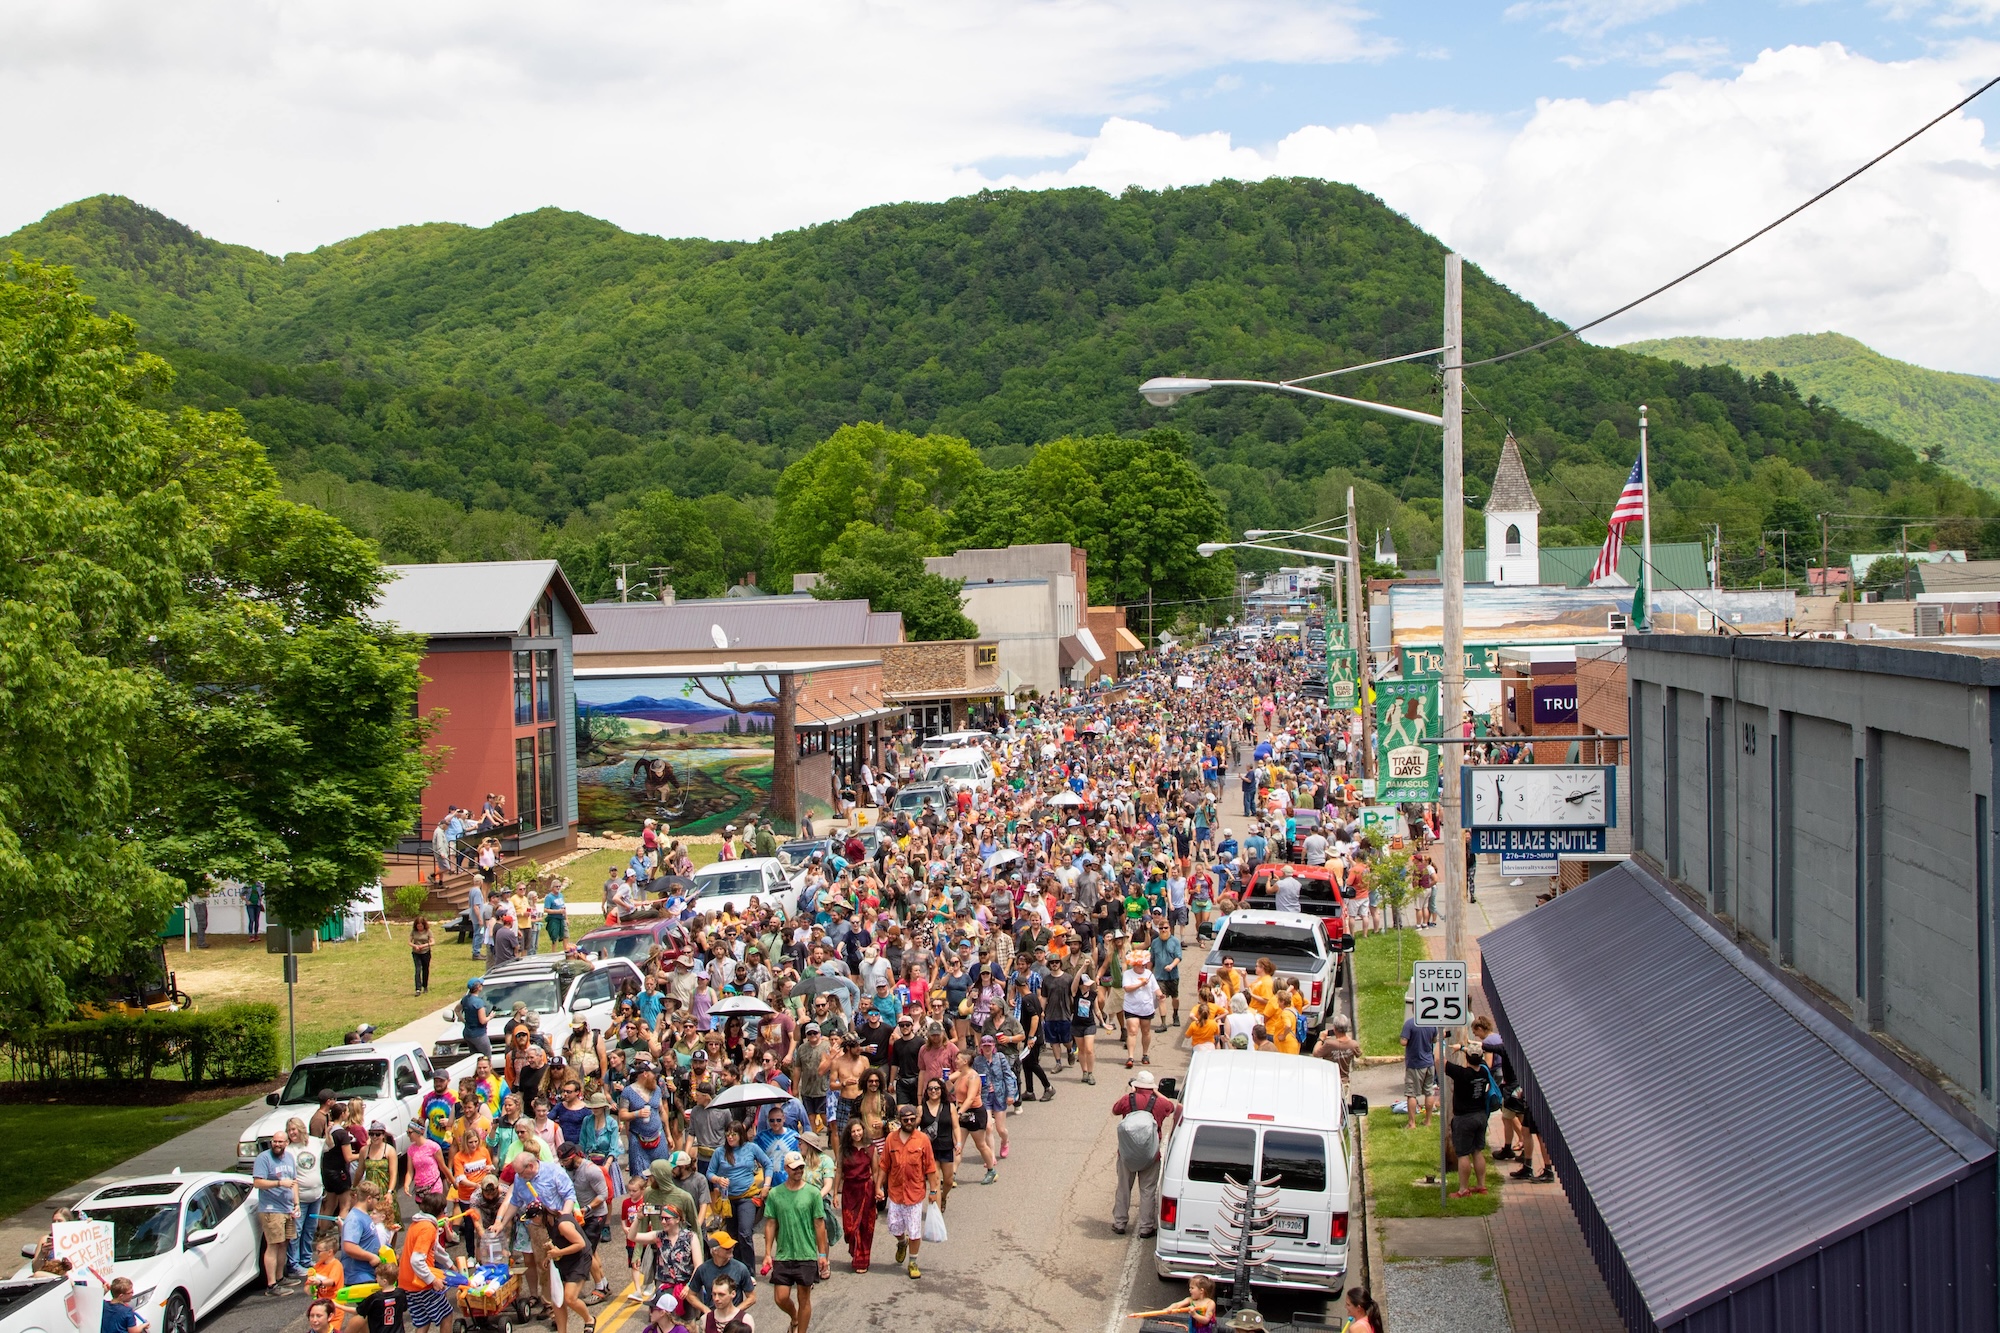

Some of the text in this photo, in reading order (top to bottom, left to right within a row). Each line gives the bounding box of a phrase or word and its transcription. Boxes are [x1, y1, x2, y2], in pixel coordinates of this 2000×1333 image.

[1405, 649, 1481, 675] TRL
[1392, 756, 1424, 766] TRAIL
[1394, 766, 1421, 776] DAYS
[1480, 830, 1597, 850] BLUE BLAZE SHUTTLE
[1420, 970, 1462, 978] SPEED
[1422, 982, 1458, 992] LIMIT
[1420, 996, 1462, 1020] 25
[60, 1226, 102, 1249] COME
[69, 1245, 96, 1270] ERE
[94, 1256, 105, 1268] THE
[384, 1306, 394, 1326] 2
